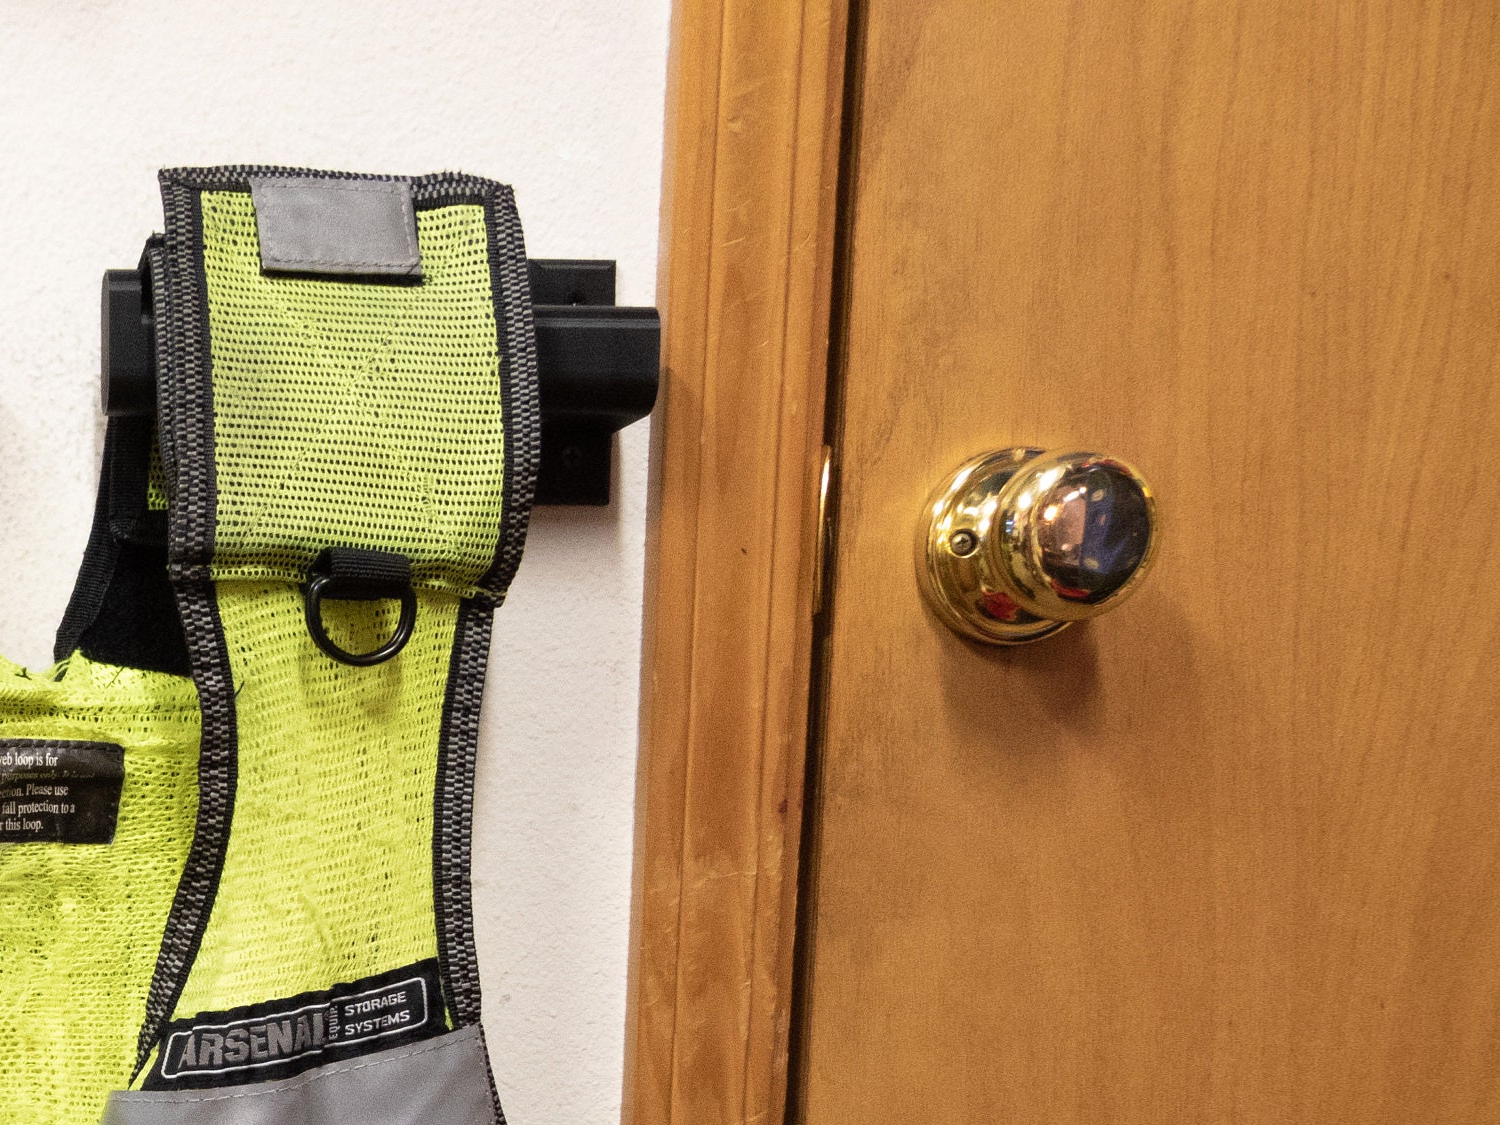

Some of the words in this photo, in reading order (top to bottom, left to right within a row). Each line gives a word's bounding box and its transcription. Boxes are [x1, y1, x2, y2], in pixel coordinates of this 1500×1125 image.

[15, 752, 34, 769] loop
[36, 752, 43, 766] is
[45, 753, 58, 766] for
[25, 783, 52, 795] Please
[54, 785, 69, 796] use
[2, 801, 16, 814] fall
[18, 800, 59, 817] protection
[61, 802, 69, 813] to
[70, 803, 75, 813] a
[5, 818, 21, 831] this
[23, 818, 44, 833] loop.
[344, 991, 407, 1018] STORAGE
[344, 1010, 411, 1036] SYSTEMS
